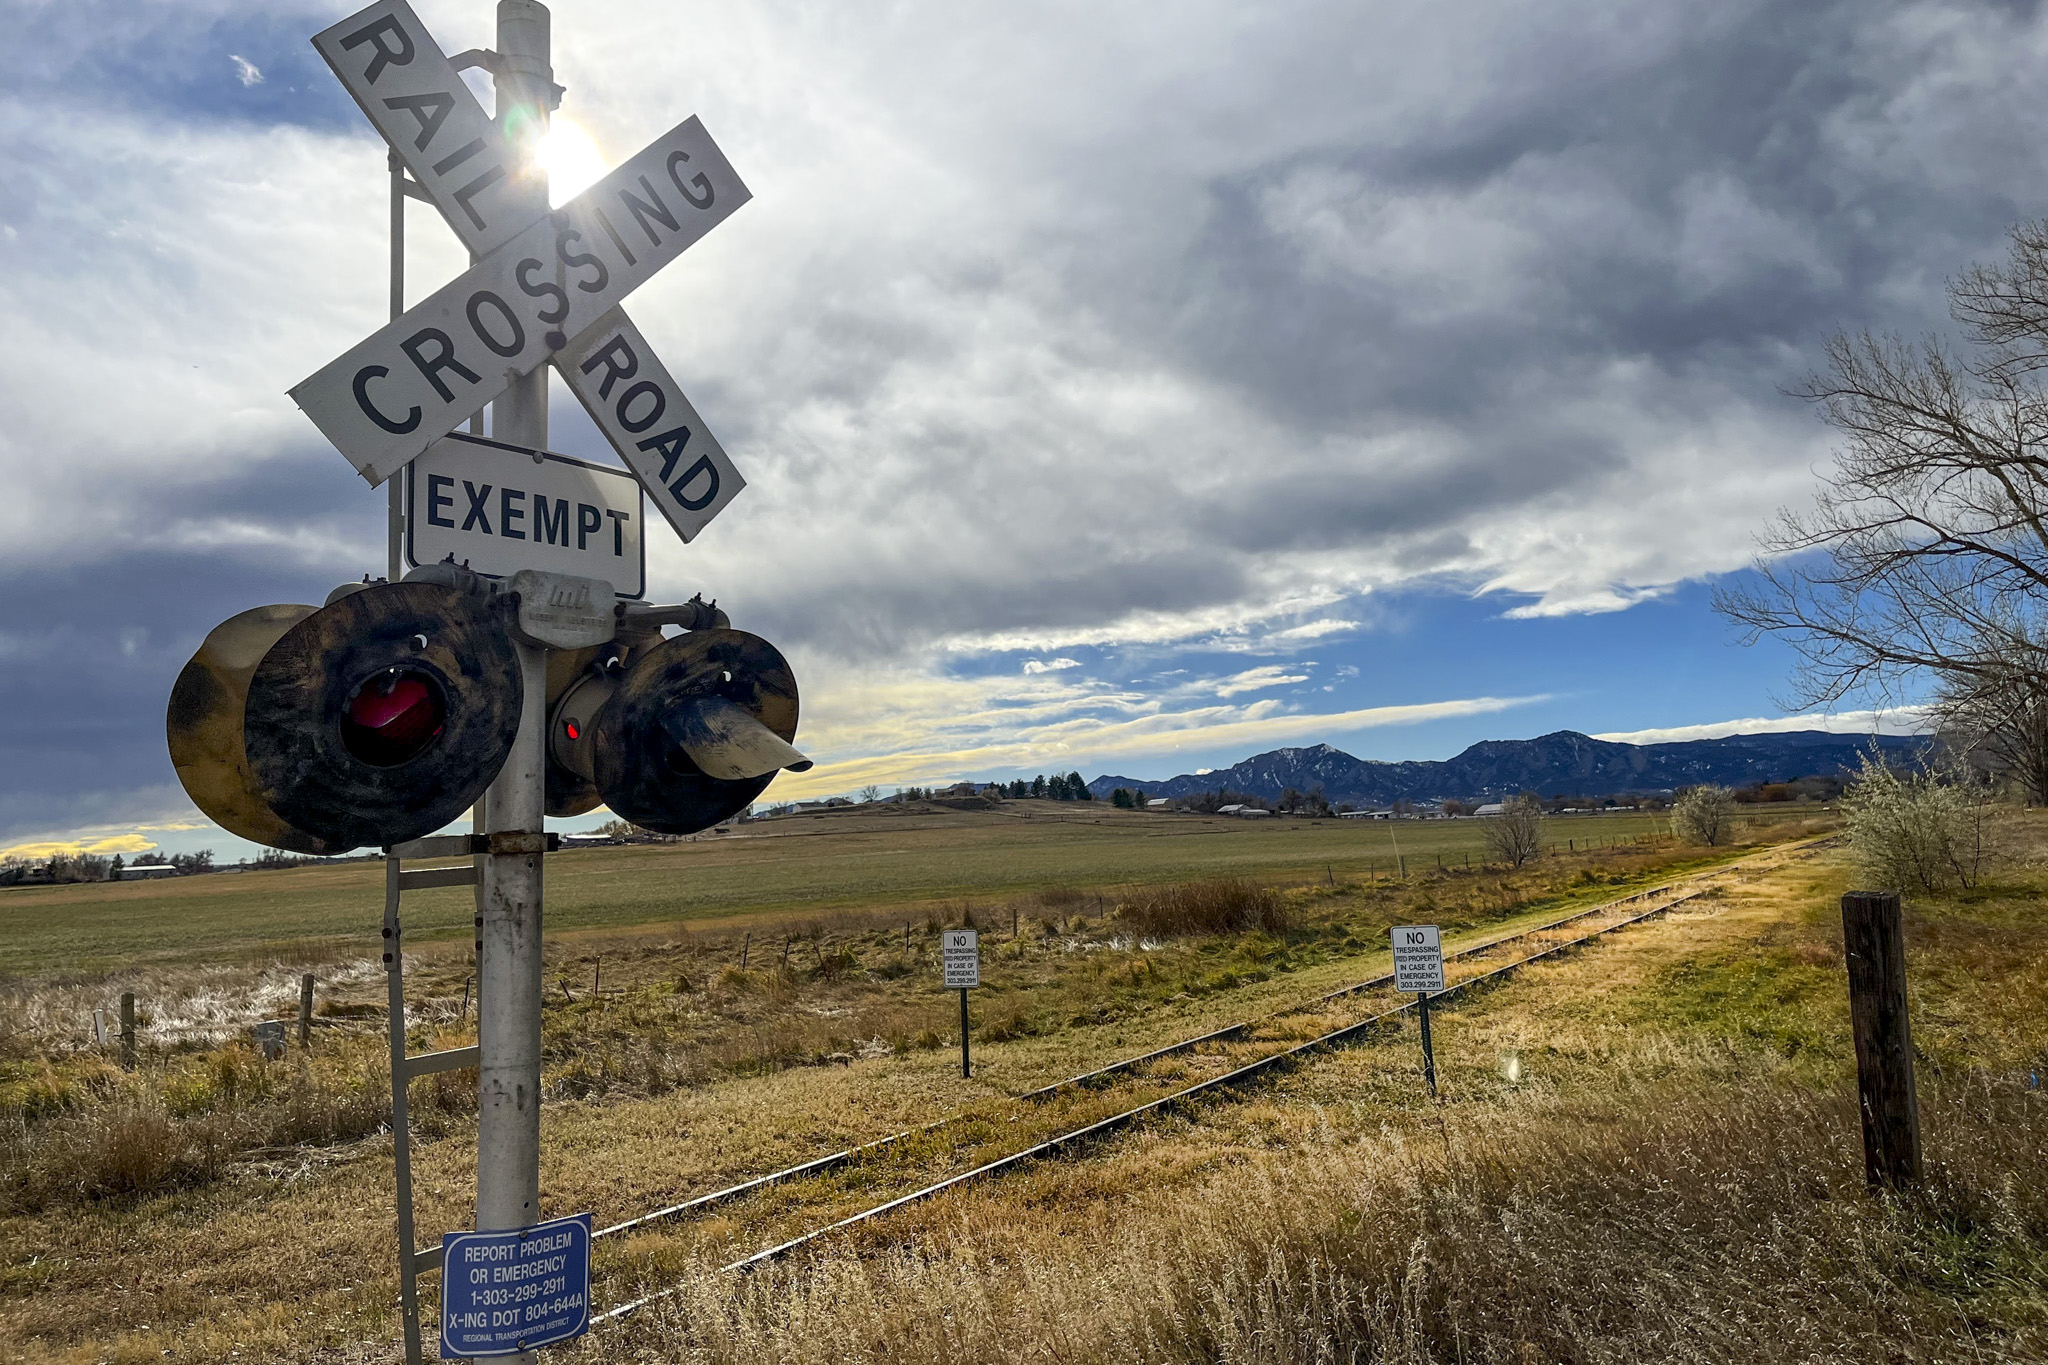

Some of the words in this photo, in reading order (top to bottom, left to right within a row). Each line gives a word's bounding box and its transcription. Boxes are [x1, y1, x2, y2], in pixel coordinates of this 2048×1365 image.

[339, 13, 507, 231] RAIL
[580, 334, 721, 511] ROAD
[352, 150, 716, 435] CROSSING
[427, 473, 631, 557] EXEMPT
[954, 936, 966, 946] NO
[1396, 946, 1439, 954] TRESPASSING
[1406, 932, 1424, 944] NO
[1400, 972, 1439, 980] EMERGENCY
[464, 1244, 516, 1263] REPORT
[520, 1231, 572, 1258] PROBLEM
[470, 1268, 488, 1284] OR
[493, 1254, 567, 1283] EMERGENCY
[470, 1276, 566, 1306] 1-303-299-2911
[449, 1311, 487, 1329] X-ING
[492, 1308, 521, 1327] DOT
[525, 1292, 583, 1322] 804-644A
[462, 1334, 493, 1343] REGIONAL
[495, 1323, 545, 1342] TRANSPORTATION
[546, 1316, 570, 1331] DISTRICT
